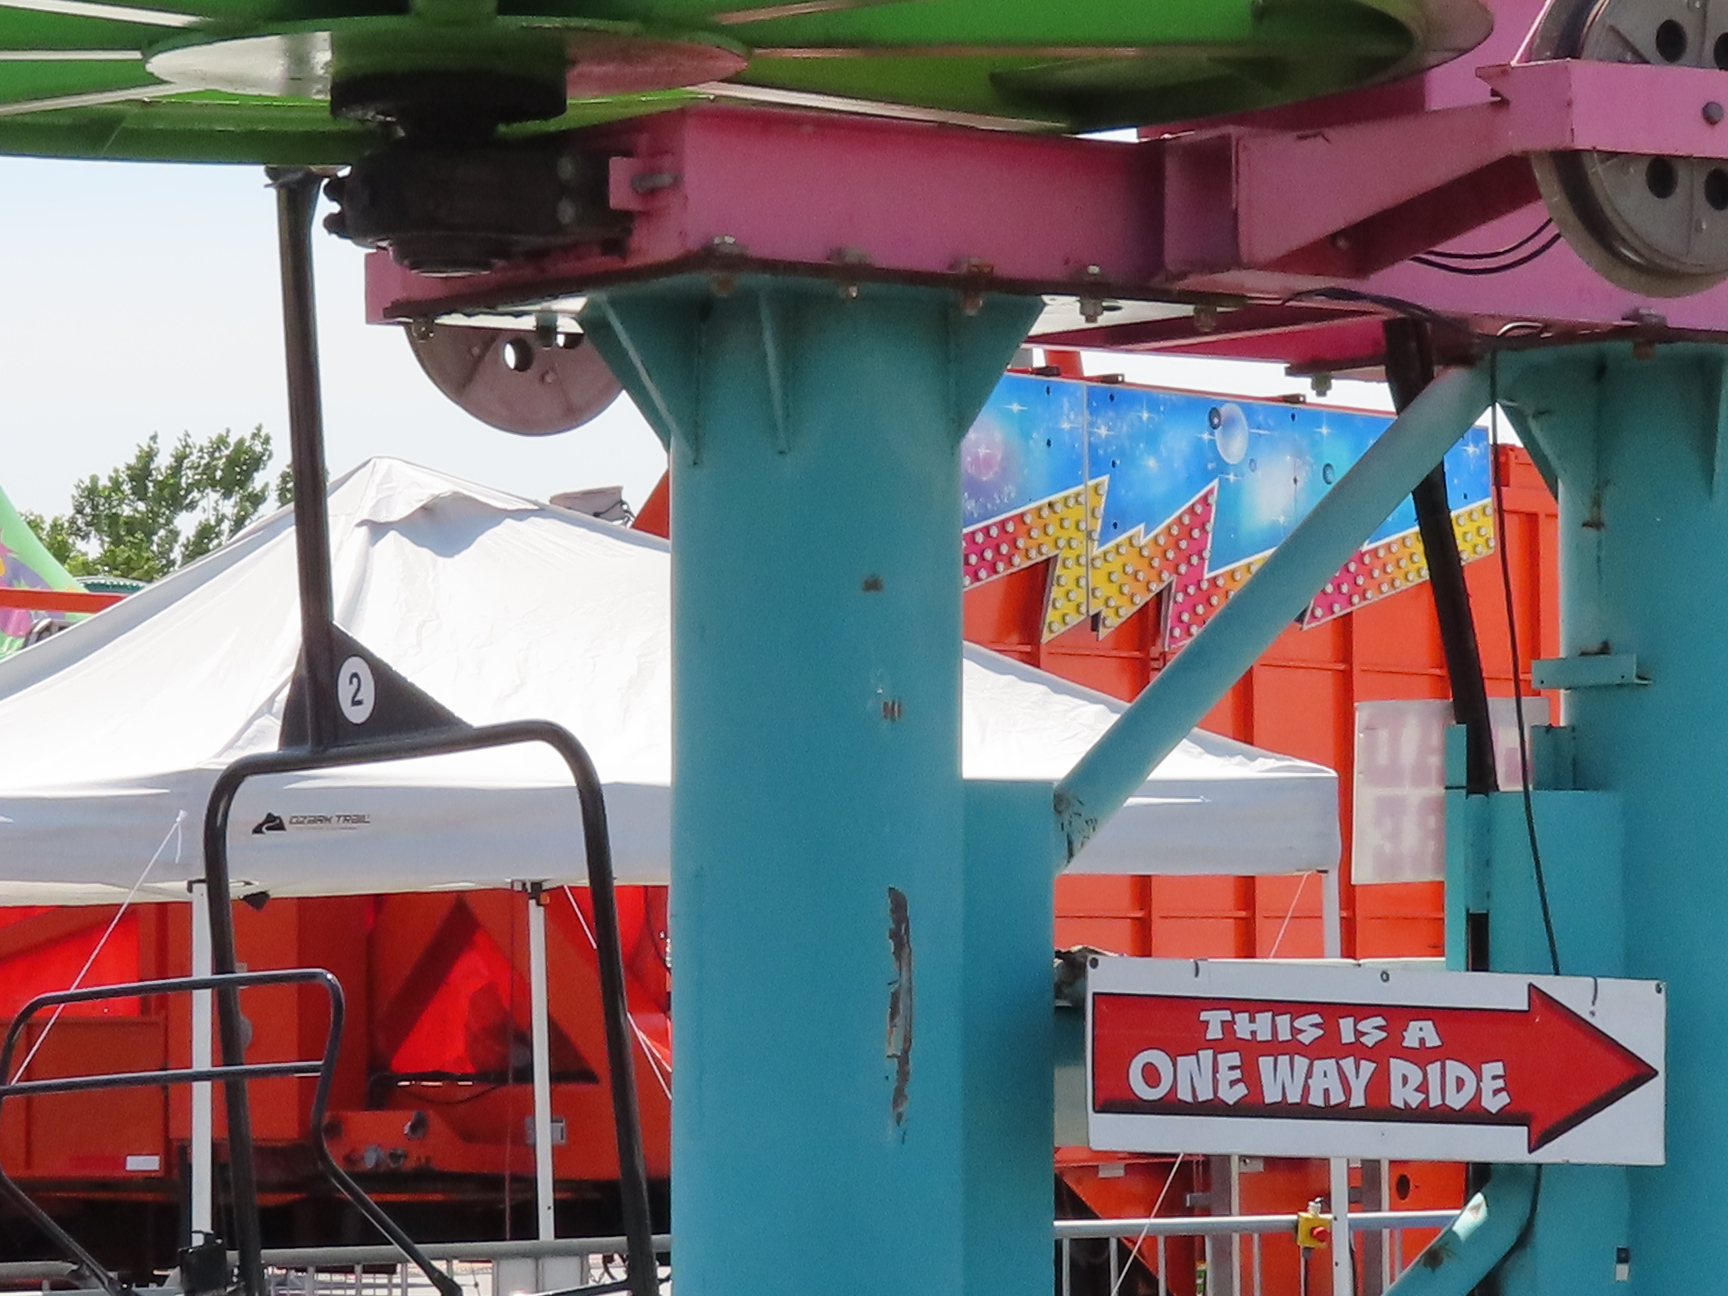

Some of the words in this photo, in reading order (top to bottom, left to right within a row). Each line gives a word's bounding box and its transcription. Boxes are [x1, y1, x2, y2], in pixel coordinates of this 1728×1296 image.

[349, 672, 364, 707] 2
[289, 815, 332, 825] OZARK
[335, 814, 370, 824] TRAIL
[1199, 1009, 1325, 1046] THIS
[1338, 1015, 1388, 1047] IS
[1401, 1019, 1443, 1049] A
[1128, 1048, 1249, 1106] ONE
[1257, 1053, 1377, 1109] WAY
[1388, 1057, 1512, 1114] RIDE
